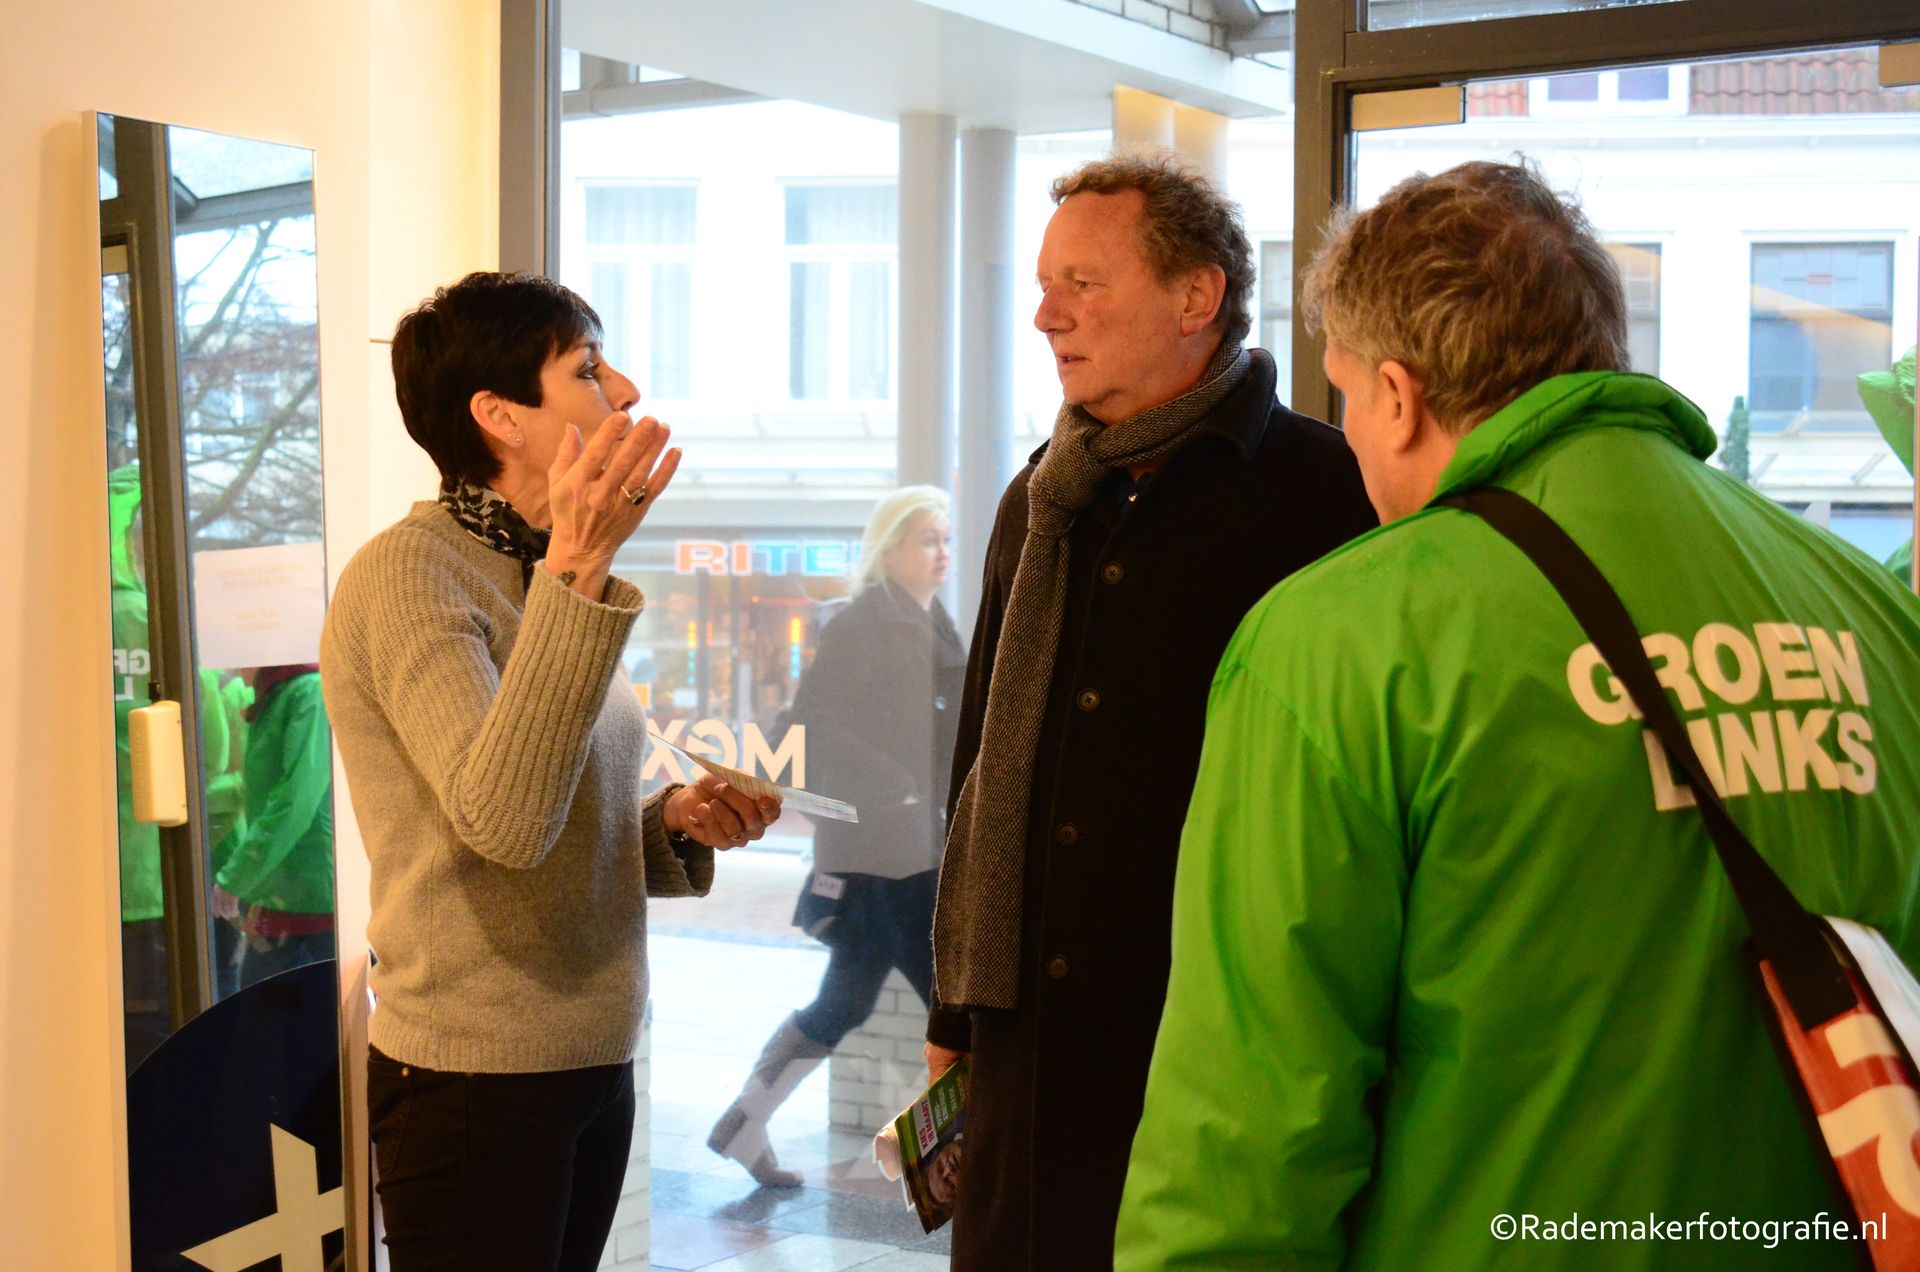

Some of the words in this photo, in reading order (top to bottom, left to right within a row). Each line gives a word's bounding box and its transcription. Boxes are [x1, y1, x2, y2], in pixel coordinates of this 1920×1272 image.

[676, 540, 864, 576] RITE
[1567, 622, 1869, 725] GROEN
[1643, 708, 1876, 811] LINKS
[921, 1100, 933, 1133] MAART
[919, 1127, 928, 1150] KIES
